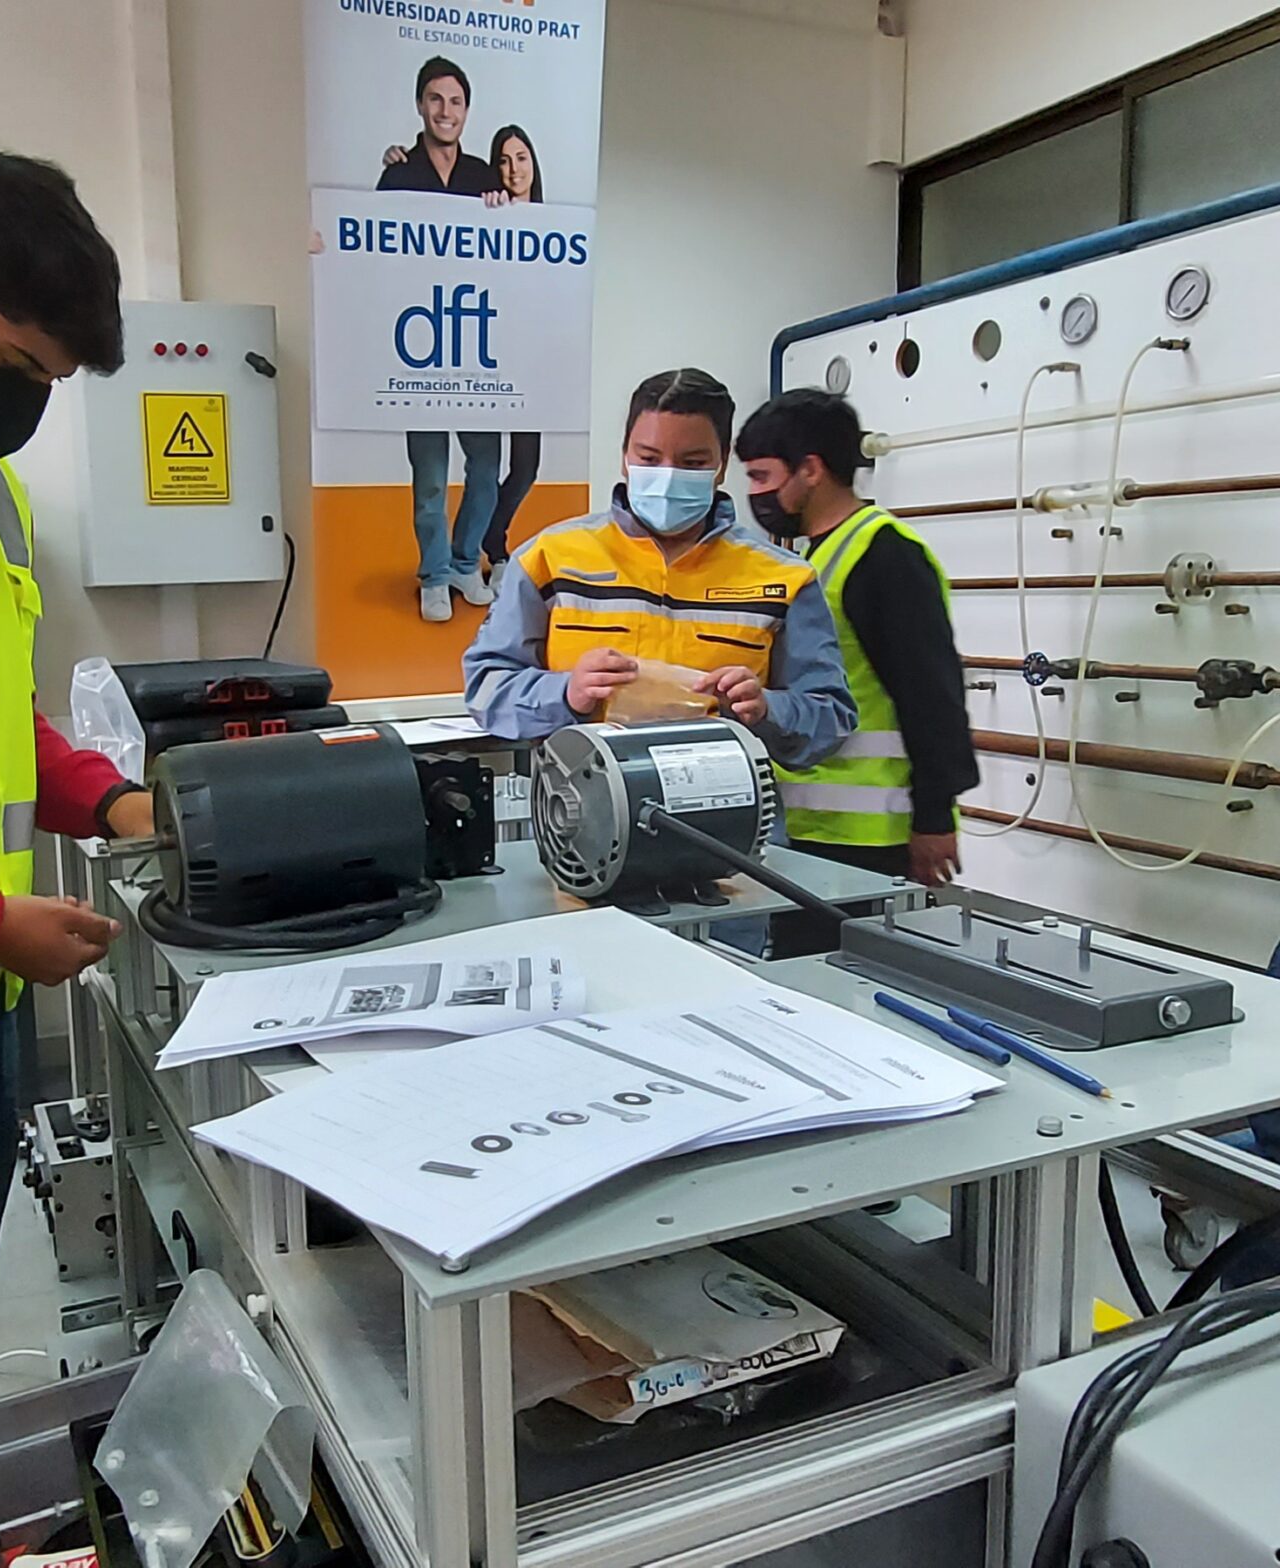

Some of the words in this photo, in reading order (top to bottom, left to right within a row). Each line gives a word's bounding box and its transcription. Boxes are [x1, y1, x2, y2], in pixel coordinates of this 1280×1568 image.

[340, 0, 461, 25] UNIVERSIDAD
[465, 11, 533, 34] ARTURO
[538, 20, 580, 40] PRAT
[399, 26, 421, 41] DEL
[424, 29, 470, 46] ESTADO
[473, 36, 488, 49] DE
[491, 38, 525, 53] CHILE
[338, 217, 587, 265] BIENVENIDOS
[394, 284, 498, 369] dft
